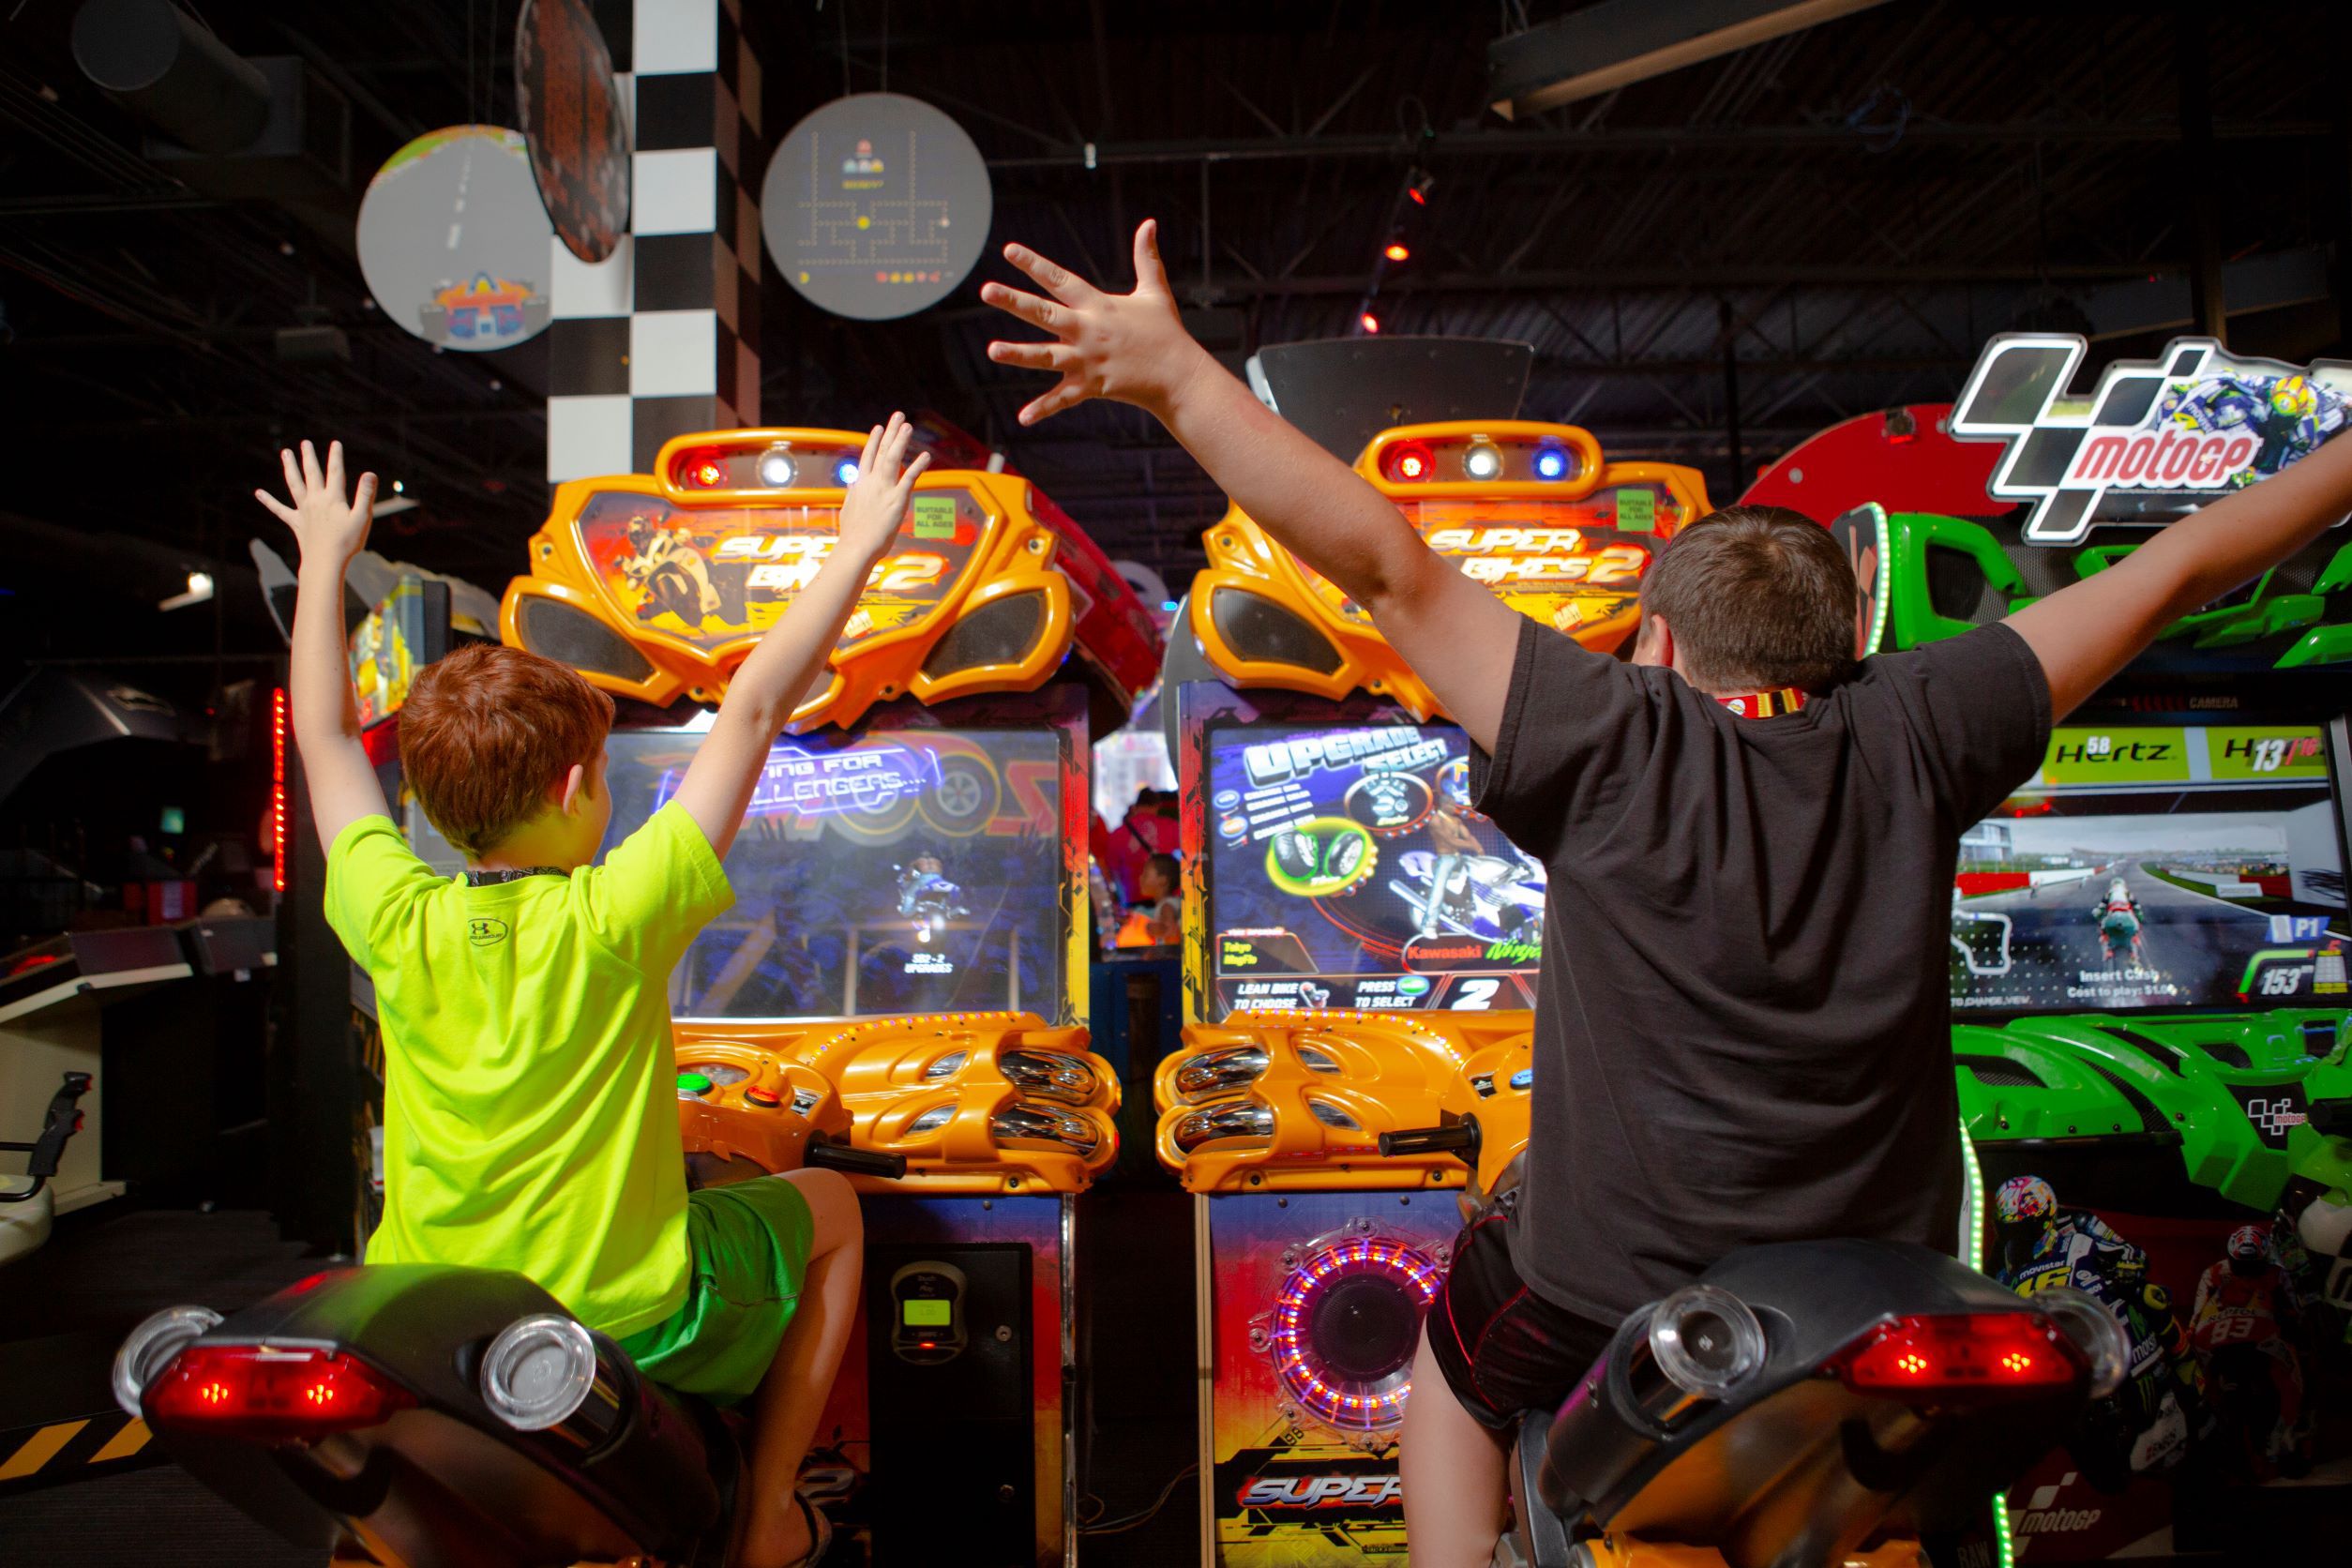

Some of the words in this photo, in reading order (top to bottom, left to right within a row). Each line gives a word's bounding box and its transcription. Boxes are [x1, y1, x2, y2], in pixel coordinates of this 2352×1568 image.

[713, 535, 840, 562] SUPE
[1429, 528, 1582, 555] SUPER
[881, 554, 944, 590] 2
[1589, 547, 1645, 583] 2
[2189, 695, 2238, 710] CAMERA
[2087, 735, 2110, 755] 58
[822, 754, 883, 774] FOR
[1244, 726, 1423, 785] UPGRADE
[1363, 738, 1447, 776] SELECT
[2294, 918, 2319, 938] P1
[1408, 944, 1483, 958] Kawasaki
[1358, 980, 1396, 993] PRESS
[2079, 970, 2122, 983] Insert
[2261, 968, 2301, 995] 153
[1238, 983, 1271, 995] LEAN
[1271, 982, 1299, 994] BIKE
[1451, 978, 1501, 1011] 2
[2067, 987, 2095, 999] Cost
[2099, 987, 2110, 998] to
[1233, 998, 1251, 1010] TO
[1250, 998, 1299, 1010] CHOOSE
[1354, 996, 1372, 1008] TO
[1371, 996, 1417, 1008] SELECT
[2019, 1259, 2065, 1280] movistar
